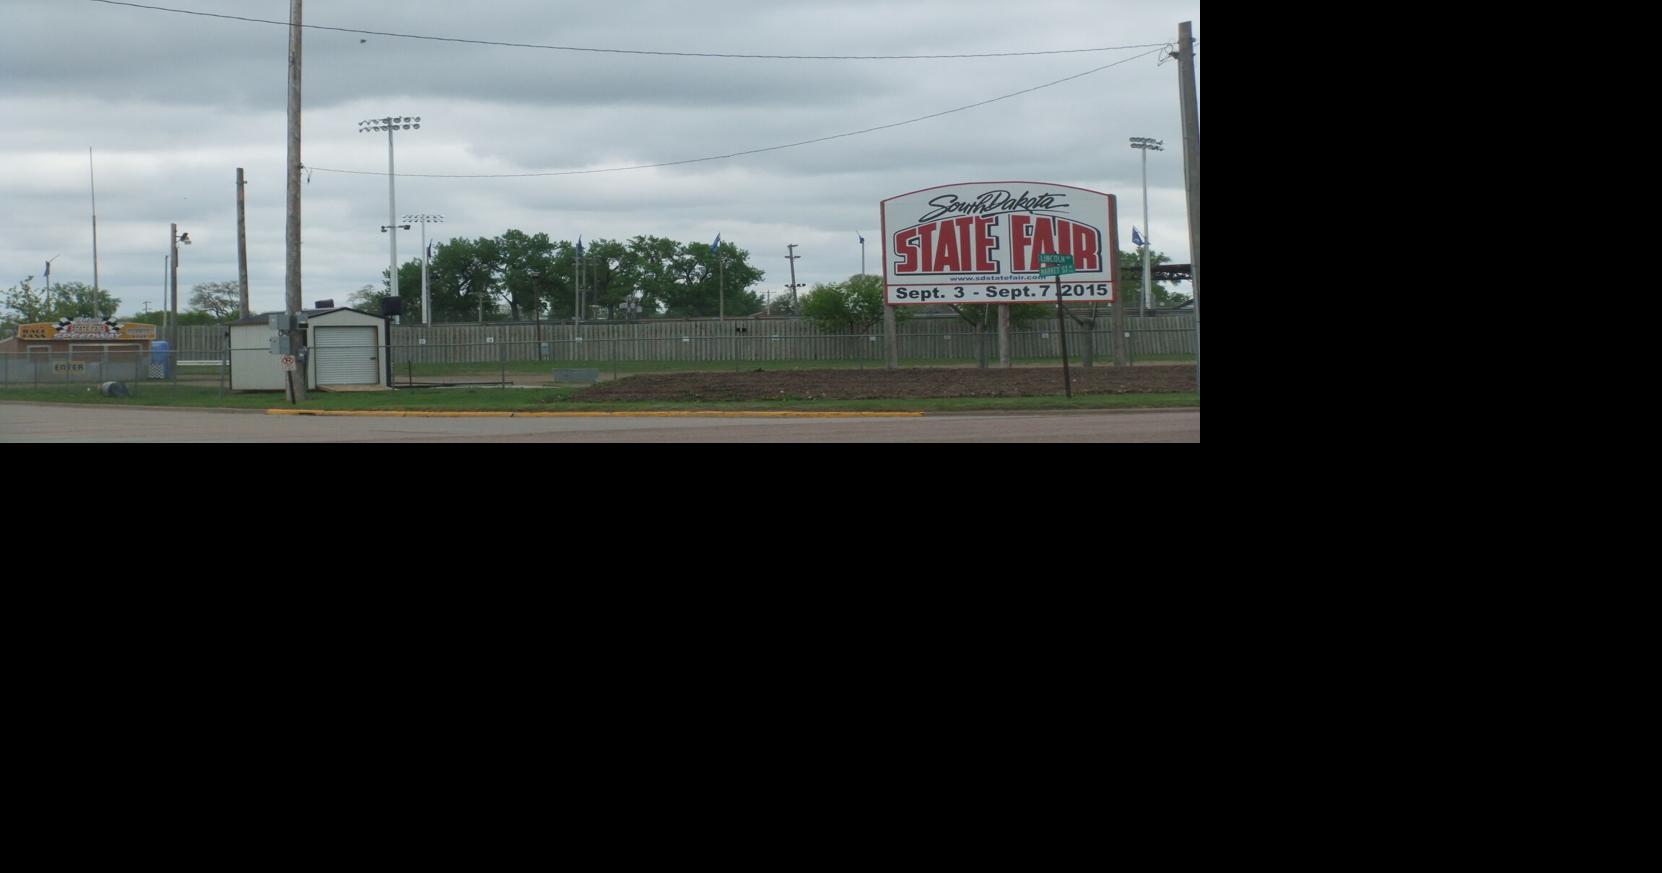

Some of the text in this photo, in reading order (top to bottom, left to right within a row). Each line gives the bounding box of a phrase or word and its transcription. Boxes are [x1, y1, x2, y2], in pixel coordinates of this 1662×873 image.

[918, 190, 1070, 222] South Dakota
[894, 213, 1102, 275] STATE FAIR
[1040, 255, 1065, 263] LINCOLN
[949, 274, 1047, 282] www.sdstatefair.com
[896, 286, 945, 301] Sept.
[954, 286, 965, 298] 3
[985, 286, 1036, 300] Sept.
[1061, 284, 1108, 297] 2015
